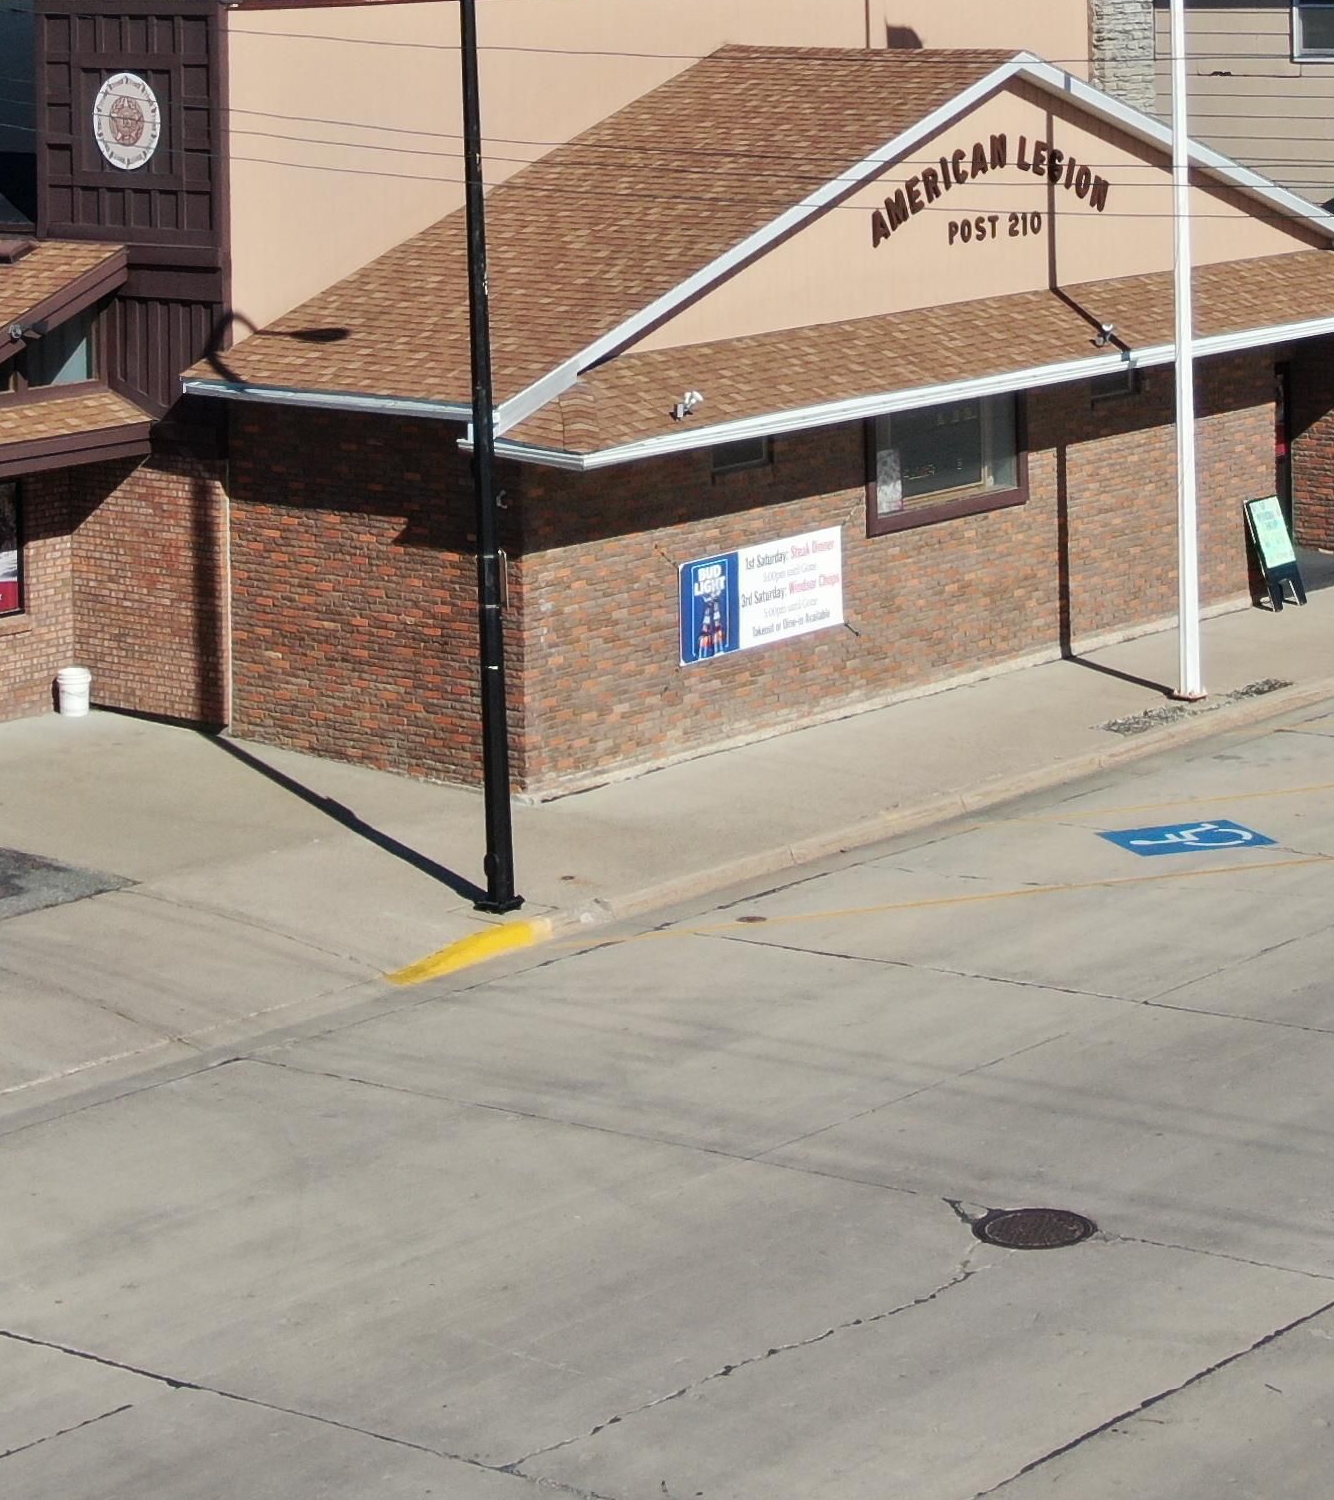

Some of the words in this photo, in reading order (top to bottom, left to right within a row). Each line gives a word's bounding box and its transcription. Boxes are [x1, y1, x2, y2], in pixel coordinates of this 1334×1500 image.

[871, 132, 1007, 249] AMERICAN
[1017, 135, 1110, 213] LEGION
[948, 214, 1000, 246] POST
[1008, 211, 1043, 238] 210
[745, 556, 755, 571] 1st
[756, 550, 789, 569] Saturday:
[790, 542, 810, 559] Steak
[811, 539, 835, 554] Dinner
[697, 564, 722, 582] BUD
[693, 575, 726, 597] LIGHT
[741, 590, 753, 608] 3rd
[754, 585, 787, 605] Saturday:
[752, 622, 775, 637] Takeout
